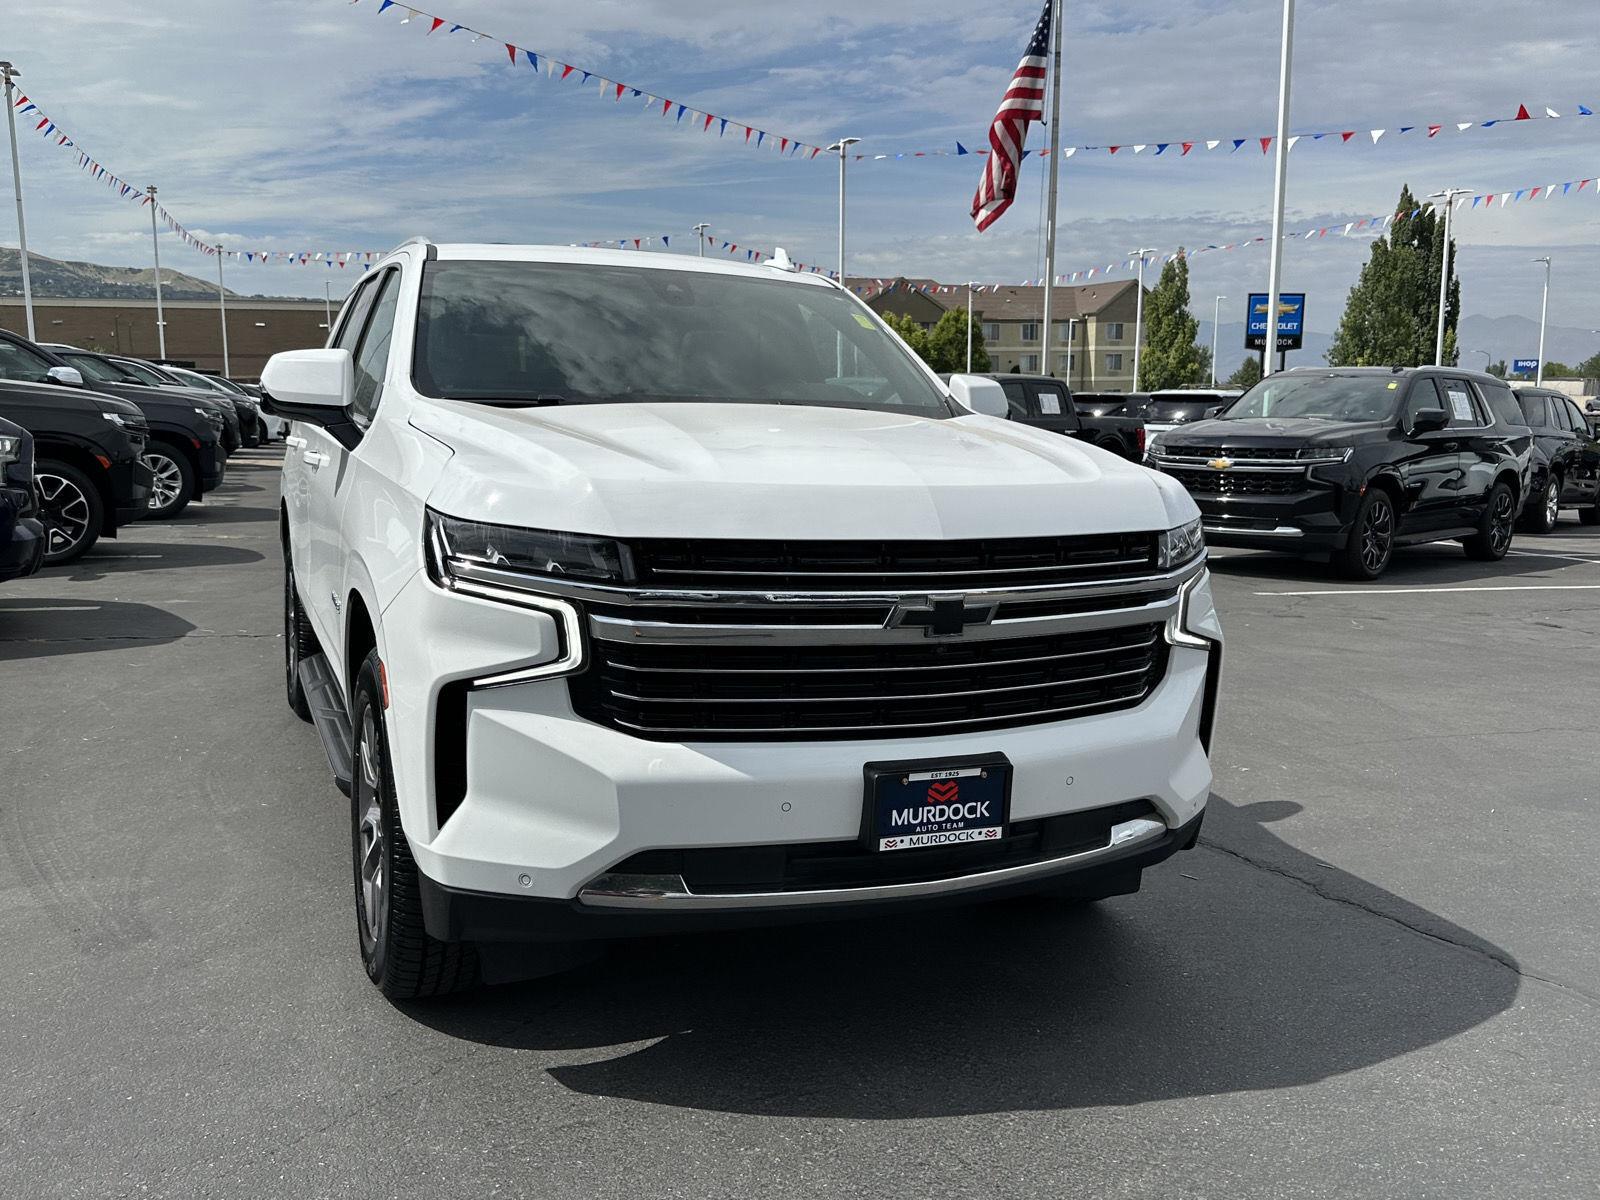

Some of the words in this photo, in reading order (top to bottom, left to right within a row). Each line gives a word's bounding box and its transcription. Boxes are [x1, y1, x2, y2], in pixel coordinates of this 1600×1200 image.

[1251, 322, 1298, 330] CHEOLET
[1254, 338, 1293, 346] MUOCK
[944, 770, 960, 778] 1925
[891, 800, 990, 827] MURDOCK
[915, 824, 938, 833] AUTO
[942, 821, 964, 831] TEAM
[909, 830, 975, 847] MURDOCK
